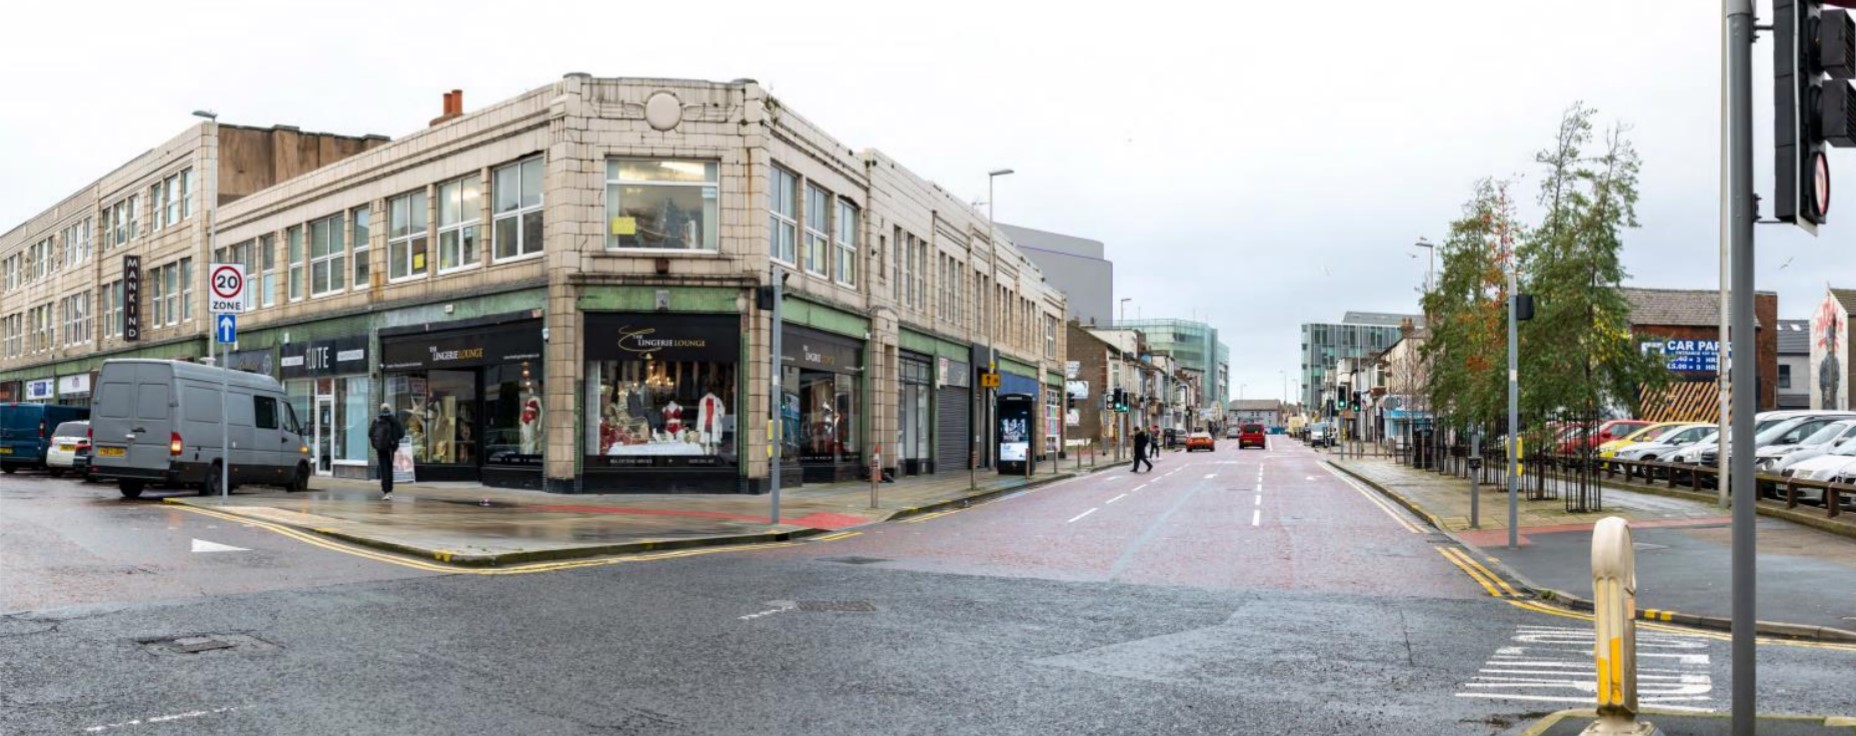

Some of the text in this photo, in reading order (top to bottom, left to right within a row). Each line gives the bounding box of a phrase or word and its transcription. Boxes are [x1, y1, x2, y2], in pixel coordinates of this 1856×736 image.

[217, 275, 238, 290] 20
[128, 259, 138, 338] MANKIND
[213, 301, 242, 310] ZONE
[638, 339, 673, 347] LINGERIE
[1667, 340, 1694, 351] CAR
